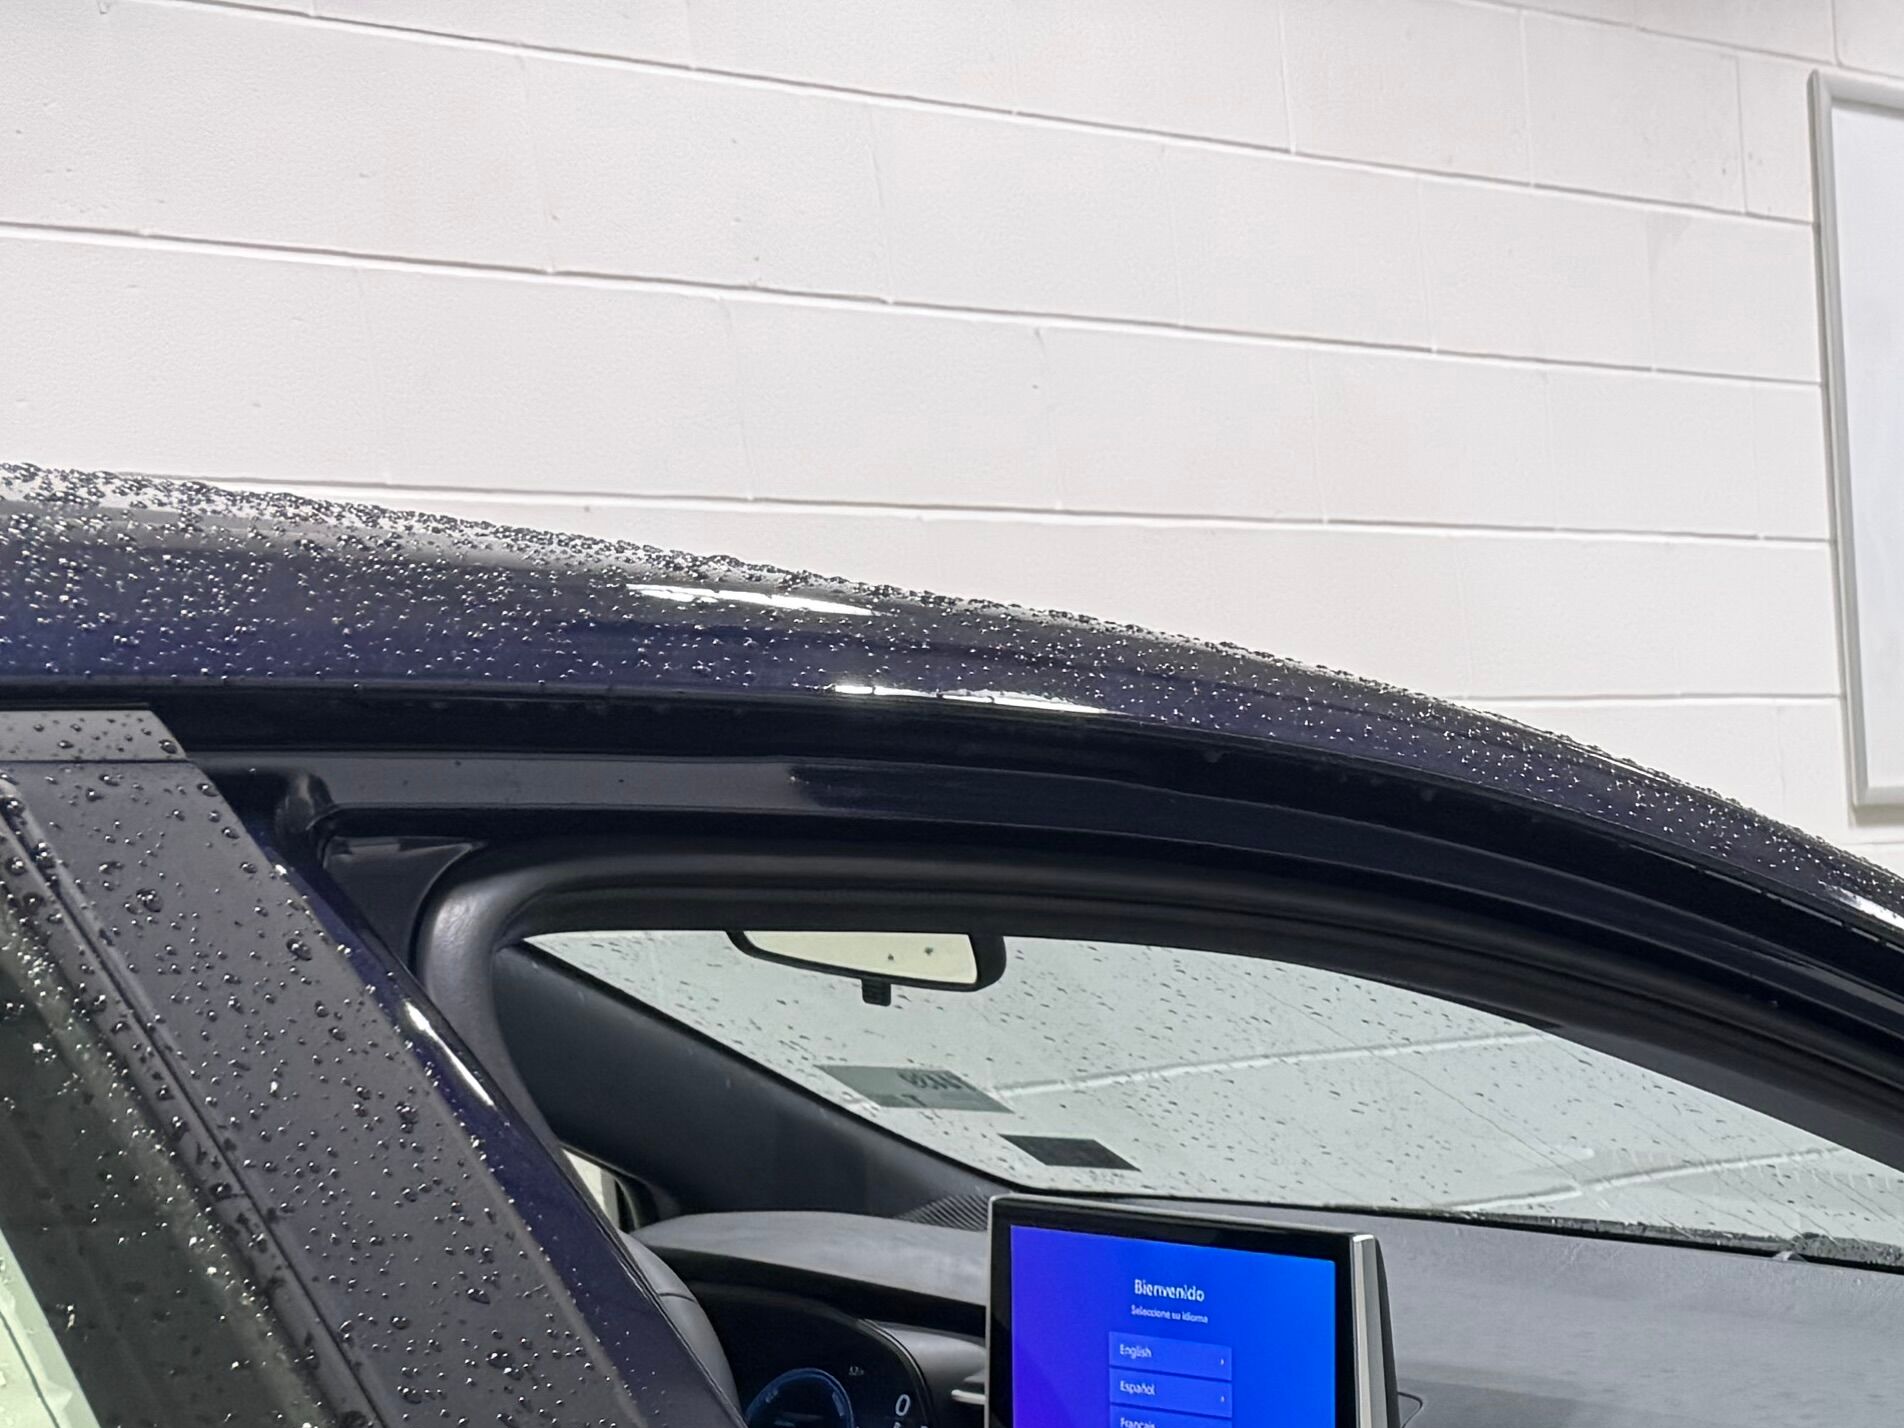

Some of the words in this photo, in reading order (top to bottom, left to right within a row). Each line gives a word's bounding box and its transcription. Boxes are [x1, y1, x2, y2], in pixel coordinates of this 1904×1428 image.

[1134, 1279, 1205, 1302] Bienvenido
[1119, 1343, 1152, 1360] English
[1119, 1380, 1156, 1396] Español
